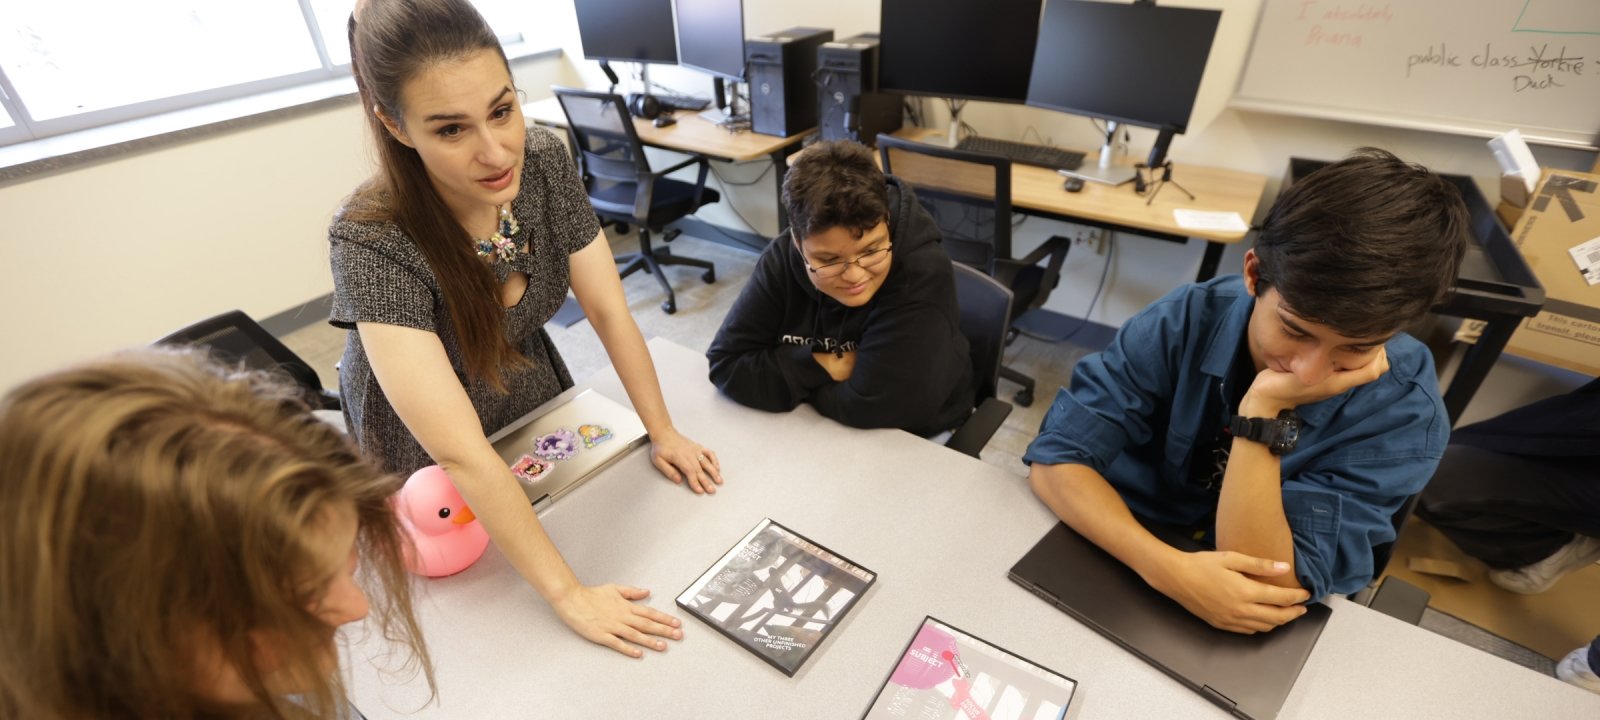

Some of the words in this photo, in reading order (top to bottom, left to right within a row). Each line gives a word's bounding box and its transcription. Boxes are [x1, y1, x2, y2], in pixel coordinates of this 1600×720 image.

[1407, 43, 1461, 78] public
[1471, 43, 1518, 69] class
[1528, 44, 1584, 75] Yorkie
[1513, 74, 1564, 92] Duck
